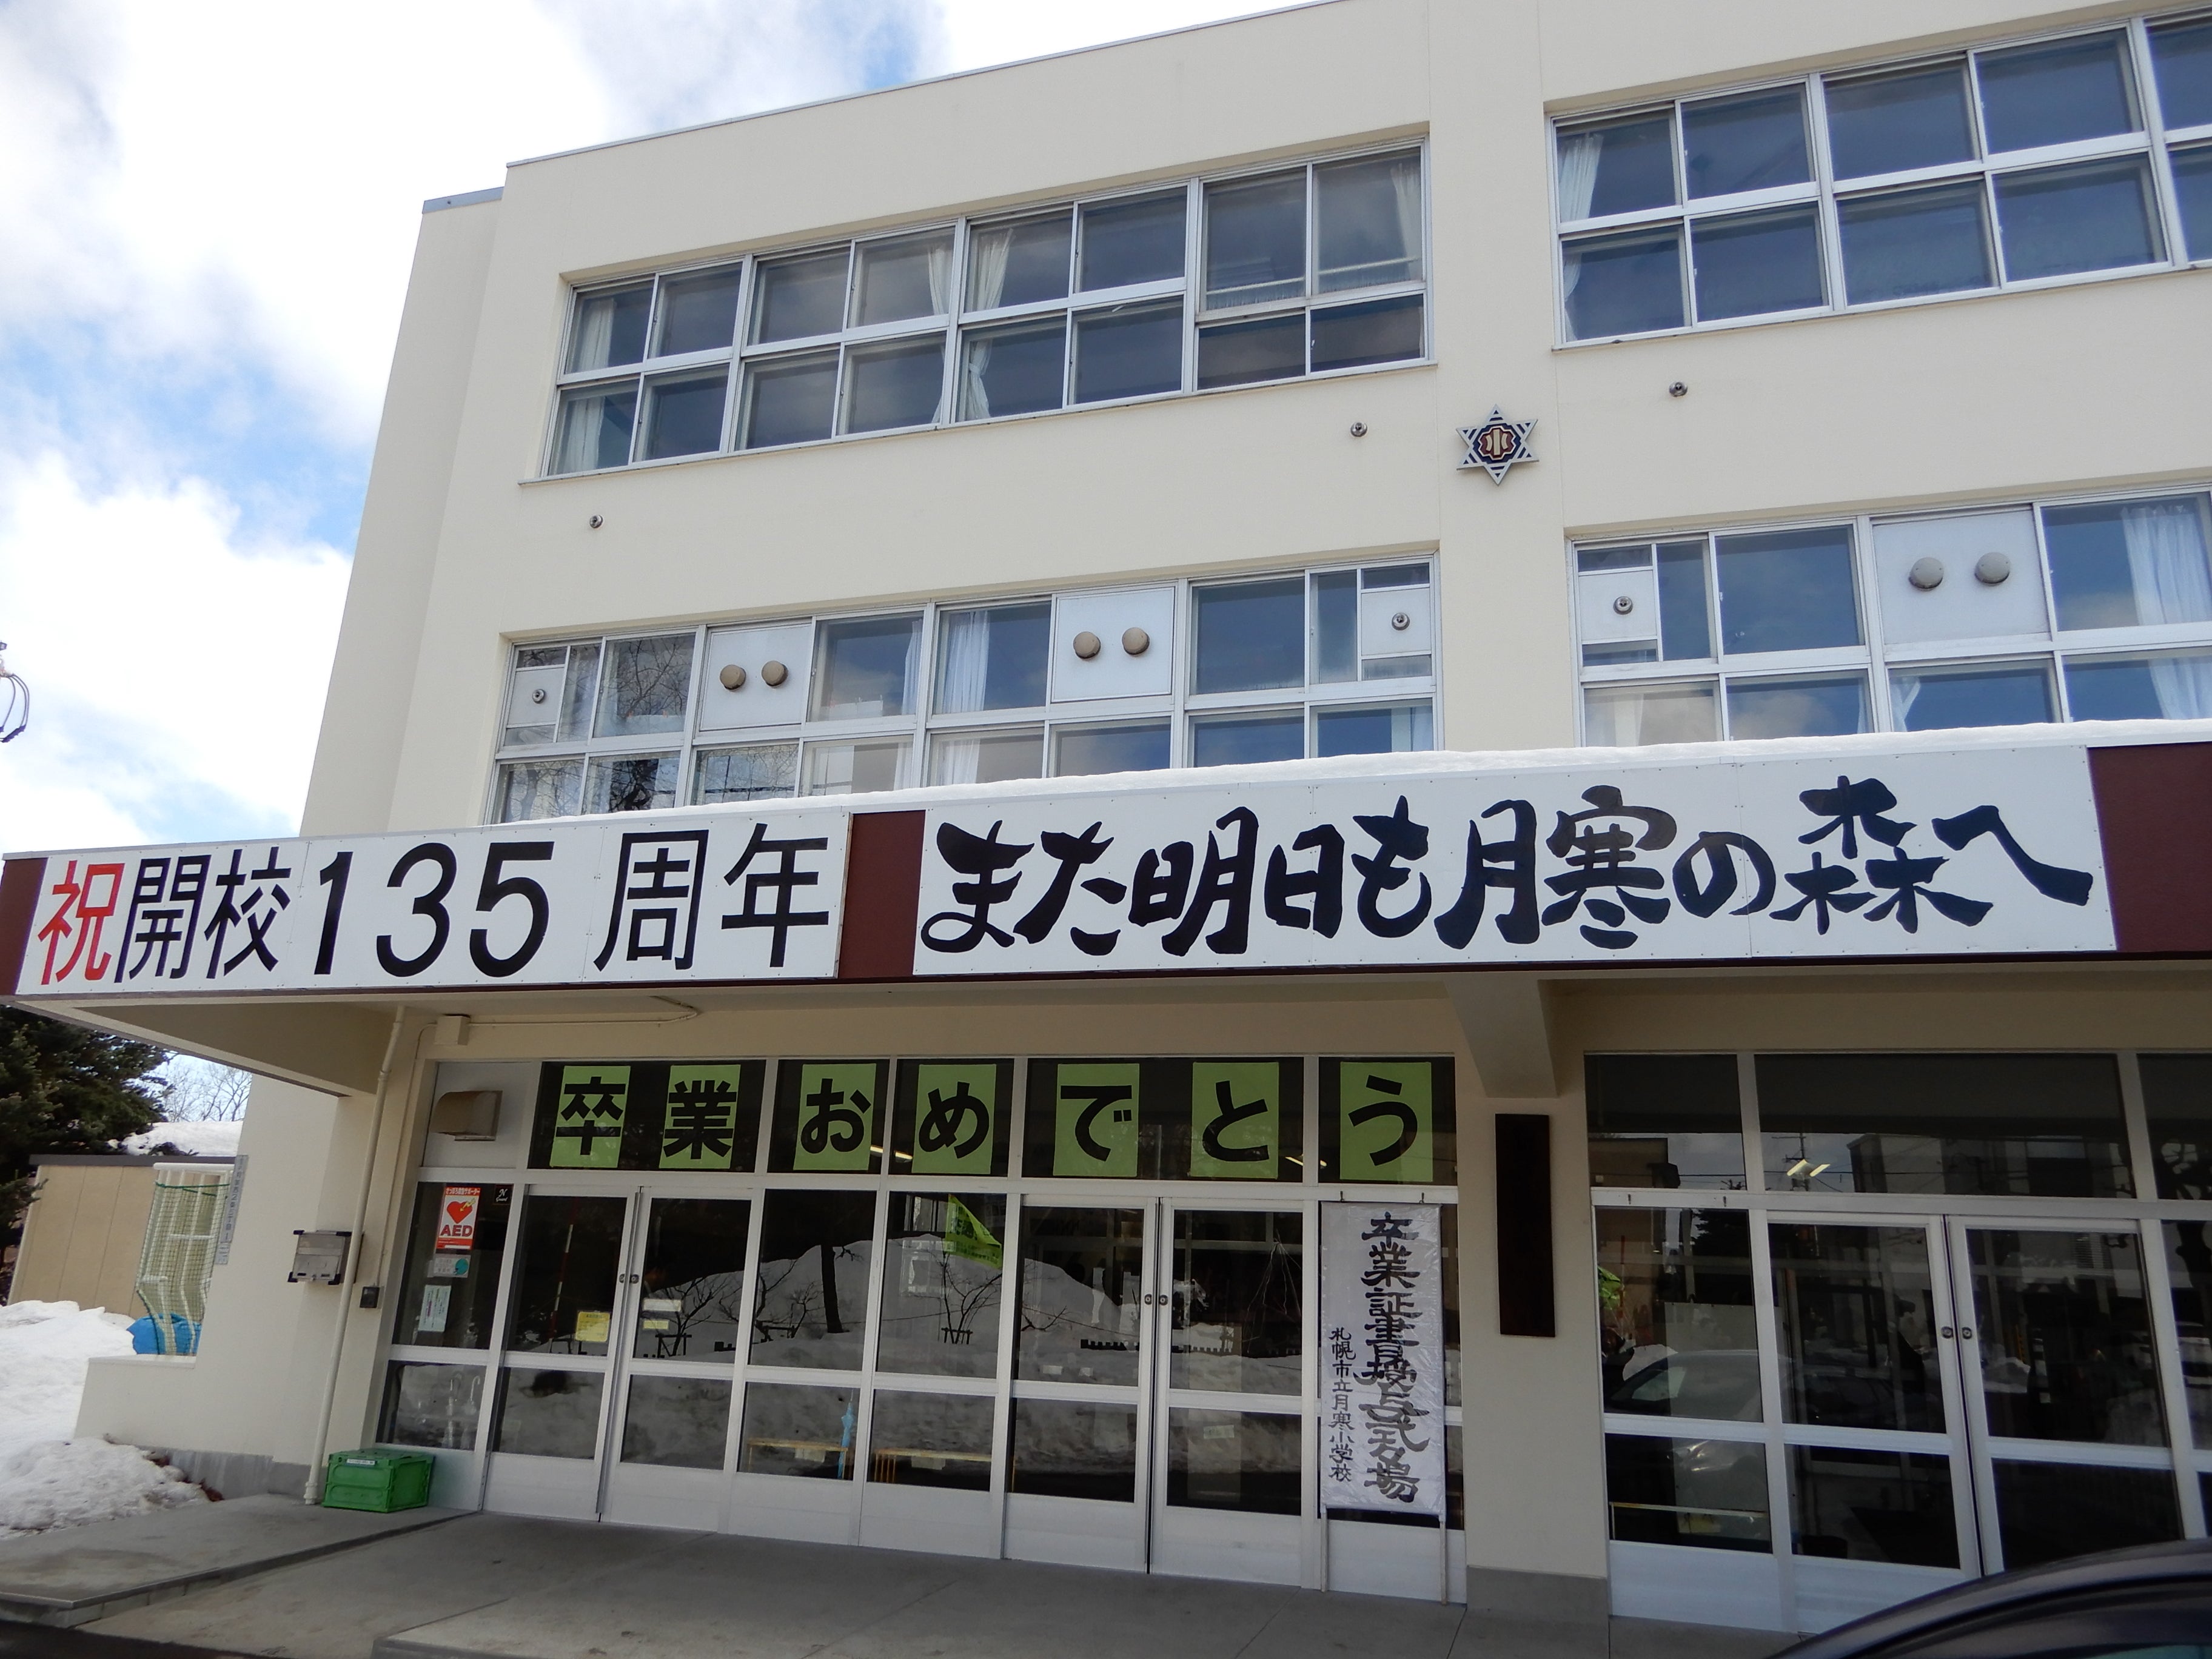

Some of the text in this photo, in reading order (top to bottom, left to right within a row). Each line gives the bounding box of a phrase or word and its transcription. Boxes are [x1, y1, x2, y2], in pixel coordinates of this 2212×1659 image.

[921, 776, 2093, 954] また明日も月寒の森へ
[558, 1074, 1418, 1166] 卒業おめでとう
[440, 1225, 472, 1236] AED
[1329, 1327, 1356, 1482] 札幌市立月寒小学校
